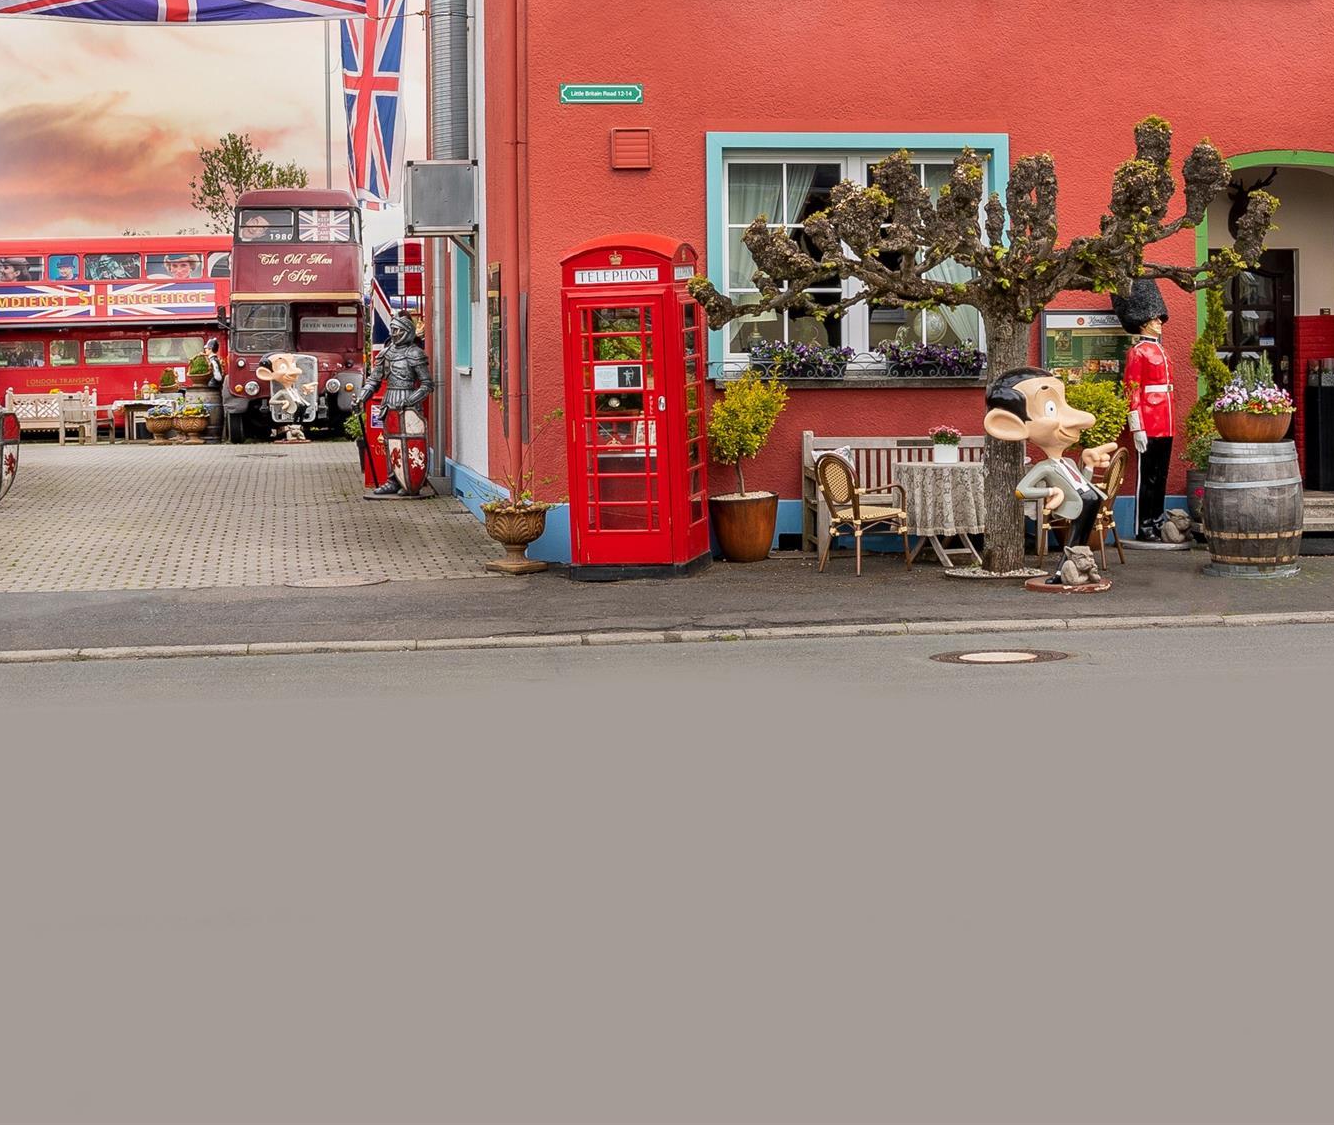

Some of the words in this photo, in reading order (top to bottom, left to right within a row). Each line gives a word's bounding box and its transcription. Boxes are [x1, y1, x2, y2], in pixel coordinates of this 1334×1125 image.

[269, 233, 293, 241] 1980
[258, 253, 279, 265] The
[284, 253, 306, 265] Old
[273, 269, 289, 286] of
[287, 268, 318, 286] Skye
[578, 270, 656, 282] TELEPHONE
[78, 292, 206, 306] SIEBENGEBIRGE
[26, 378, 57, 387] LONDON
[59, 377, 100, 385] TRANSPORT
